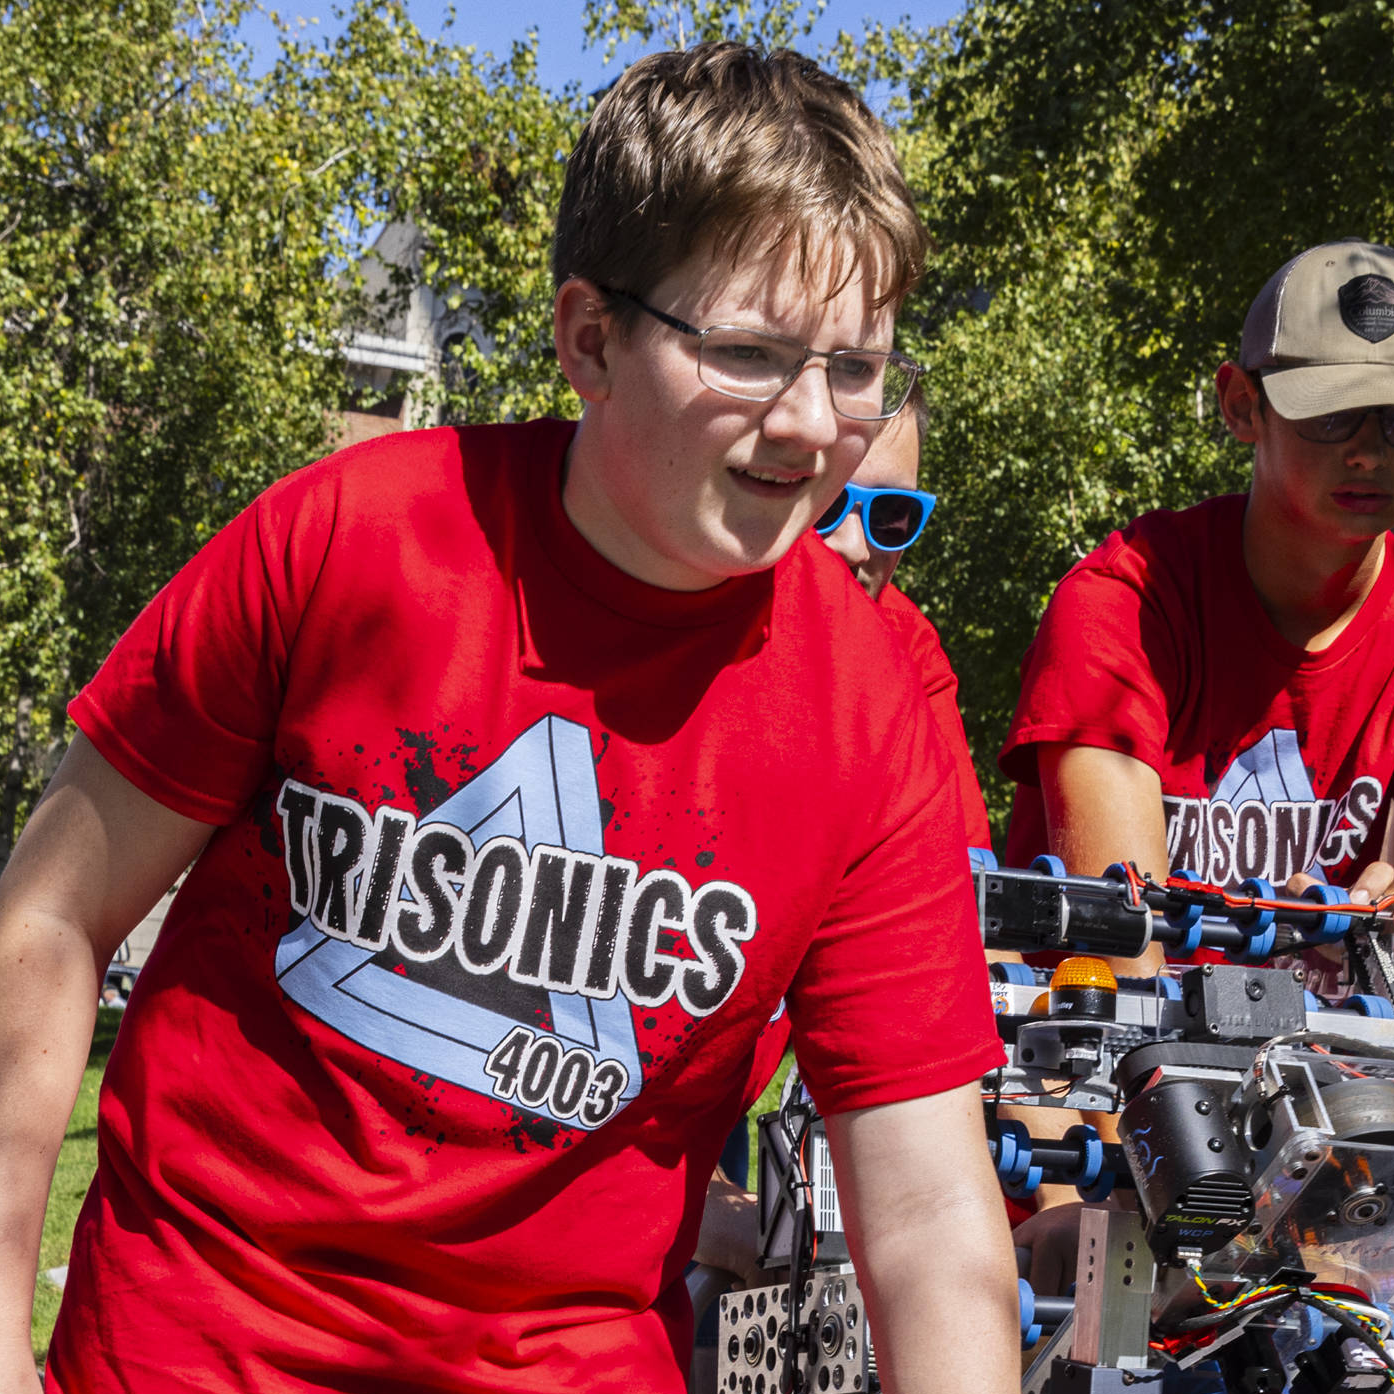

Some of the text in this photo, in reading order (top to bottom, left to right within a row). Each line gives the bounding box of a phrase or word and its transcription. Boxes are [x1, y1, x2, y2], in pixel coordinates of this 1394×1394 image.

[276, 779, 756, 1017] TRISONICS
[484, 1027, 628, 1127] 4003
[1165, 1214, 1217, 1225] TALON
[1178, 1228, 1215, 1237] WCP
